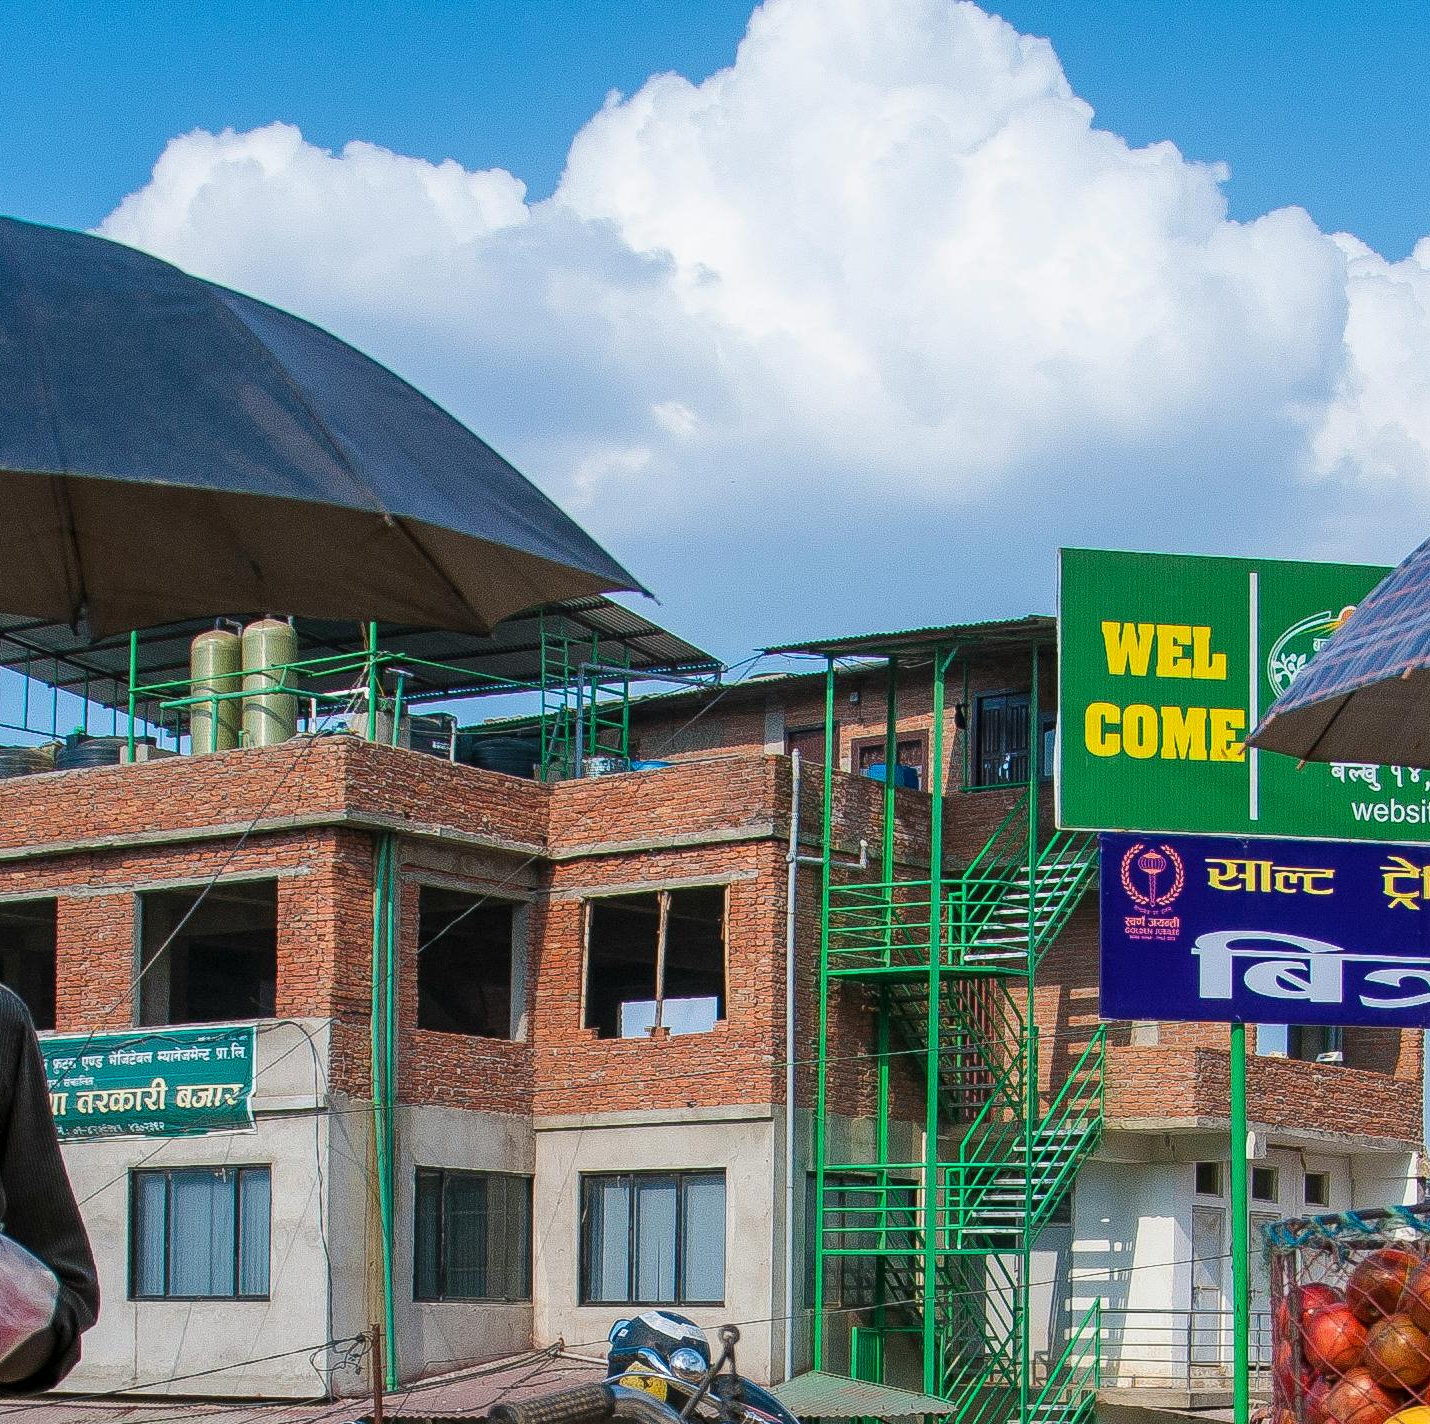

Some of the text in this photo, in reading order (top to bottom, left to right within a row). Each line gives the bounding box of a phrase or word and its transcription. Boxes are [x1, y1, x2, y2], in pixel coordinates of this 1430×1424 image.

[1101, 621, 1227, 680] WEL
[1085, 702, 1245, 762] COME
[1205, 858, 1336, 895] साल्ट
[76, 1078, 169, 1115] तरकारी
